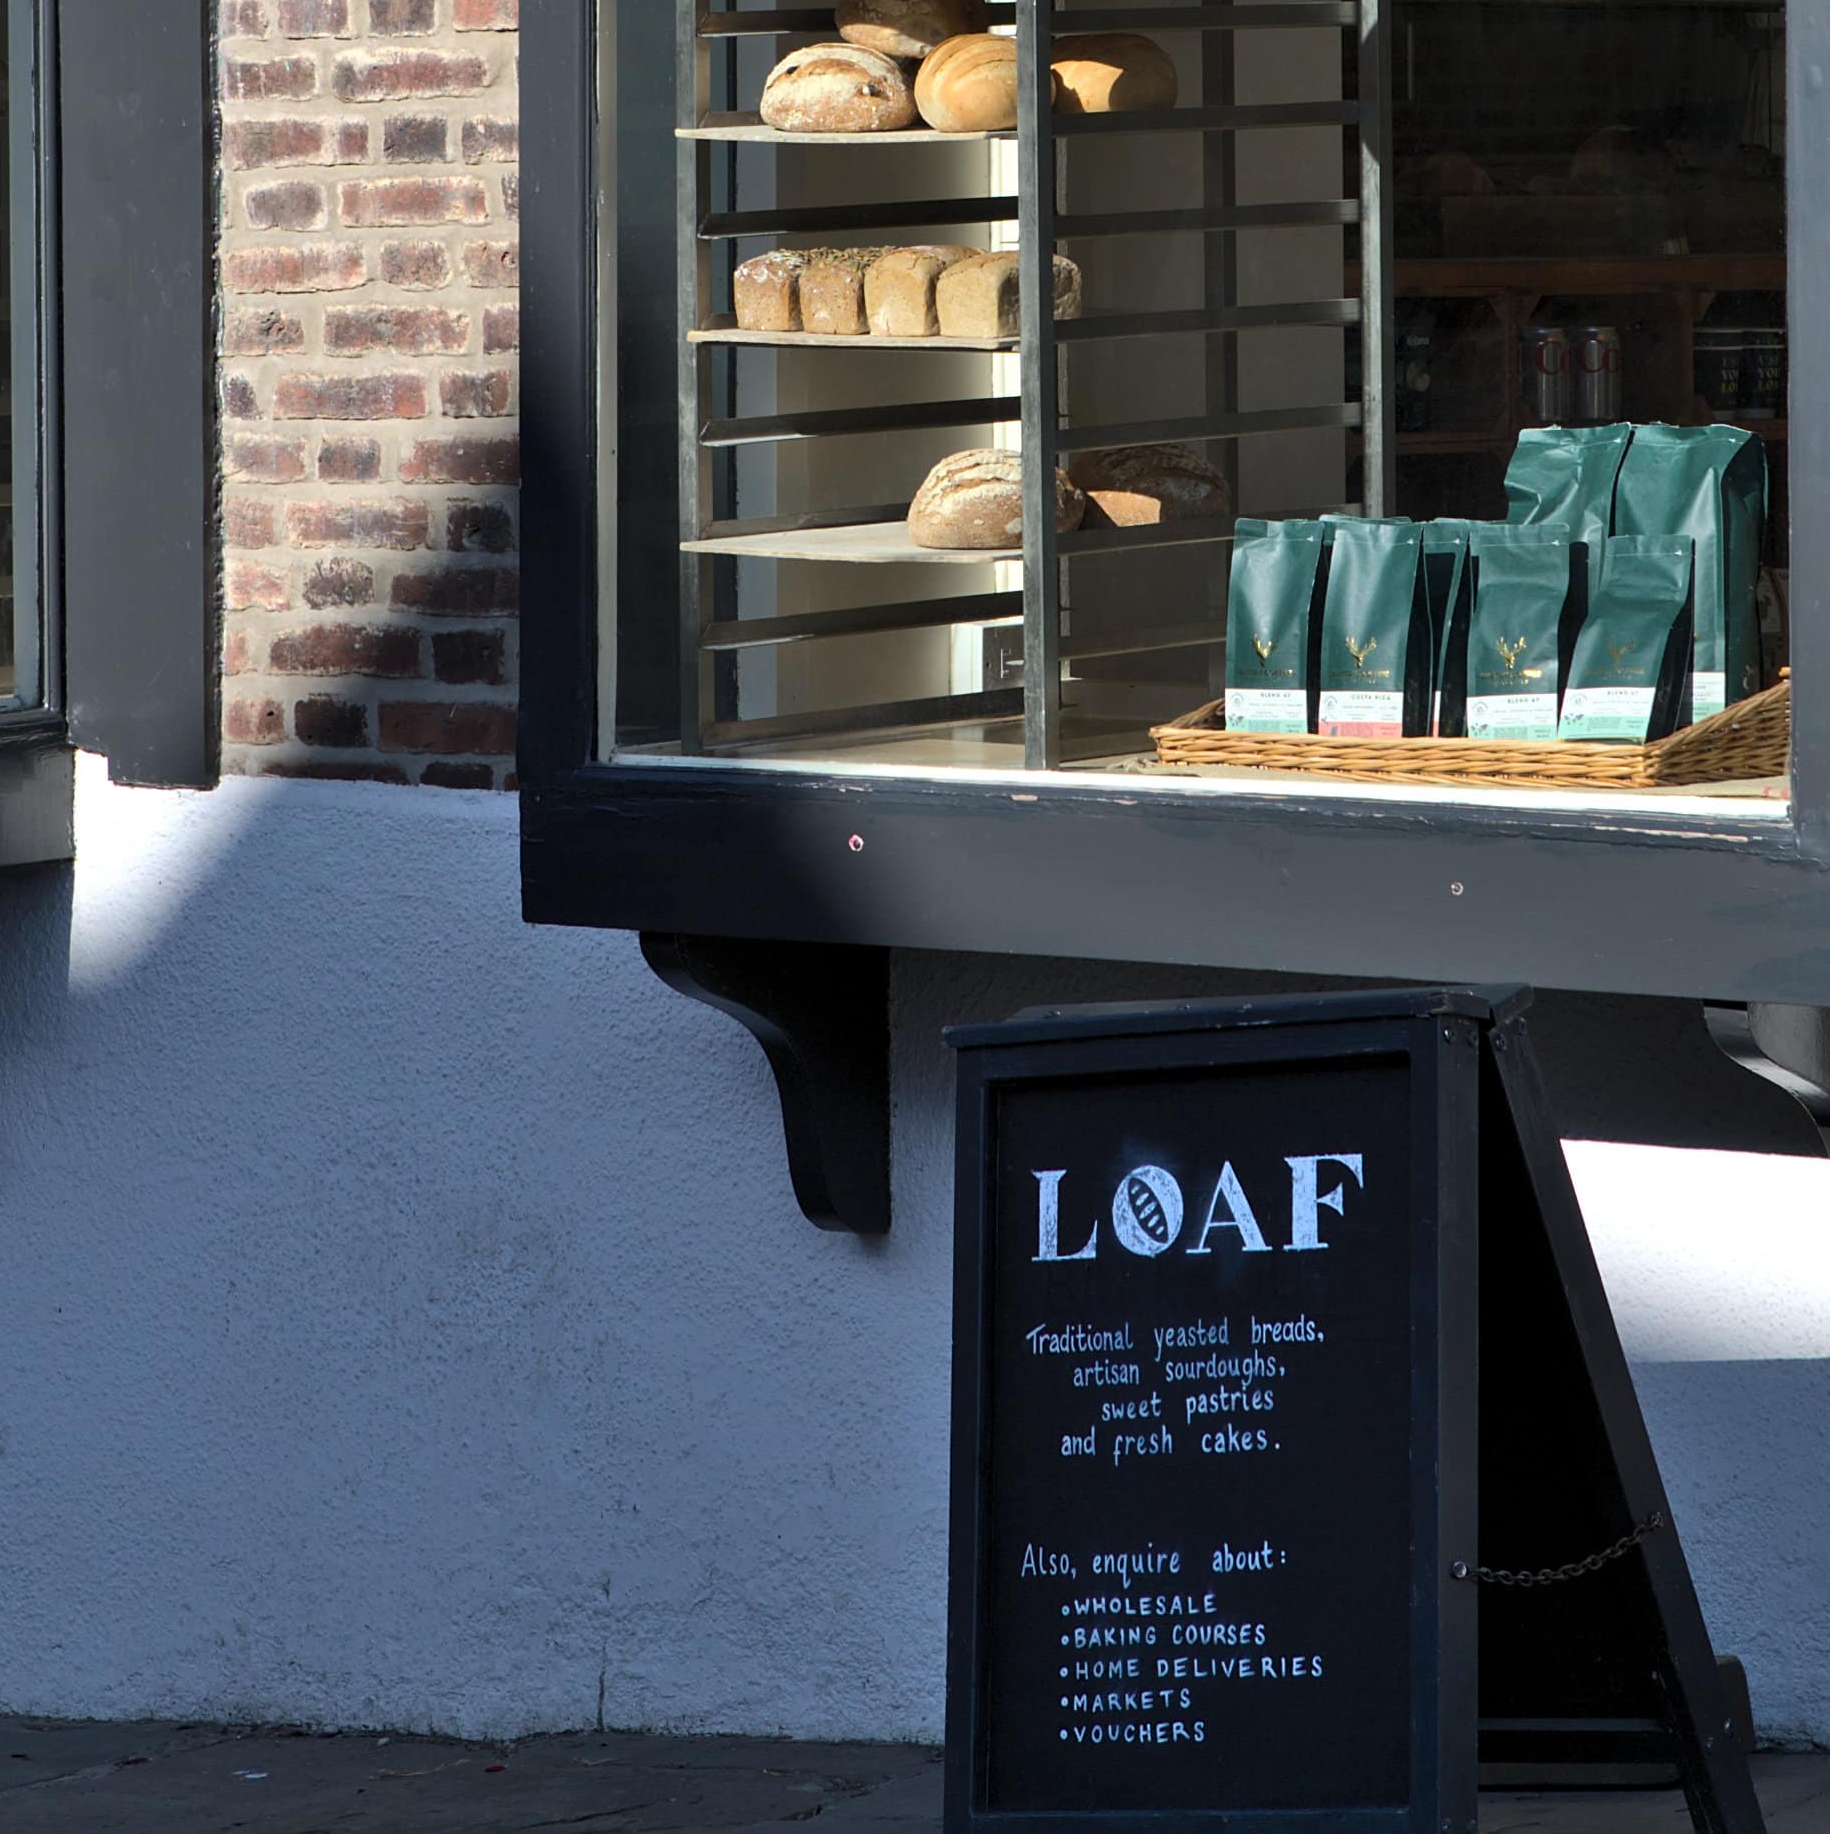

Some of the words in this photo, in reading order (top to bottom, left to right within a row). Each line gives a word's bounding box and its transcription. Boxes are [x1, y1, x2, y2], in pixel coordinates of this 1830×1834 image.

[1031, 1153, 1365, 1262] LOAF
[1026, 1321, 1134, 1356] Traditional
[1153, 1317, 1230, 1363] yeasted
[1250, 1313, 1325, 1344] breads,
[1073, 1358, 1140, 1387] artisan
[1165, 1349, 1287, 1387] sourdoughs,
[1101, 1391, 1162, 1422] sweet
[1186, 1384, 1274, 1425] pastries
[1061, 1425, 1096, 1457] and
[1112, 1424, 1173, 1468] fresh
[1201, 1422, 1282, 1454] cakes.
[1021, 1542, 1078, 1580] Also,
[1092, 1542, 1181, 1590] enquire
[1212, 1539, 1288, 1573] about:
[1073, 1593, 1218, 1616] WHOLESALE
[1074, 1625, 1157, 1650] BAKING
[1172, 1623, 1266, 1646] COURSES
[1075, 1658, 1140, 1680] HOME
[1156, 1655, 1324, 1679] DELIVERIES
[1073, 1688, 1192, 1713] MARKETS
[1073, 1720, 1206, 1743] VOUCHERS
